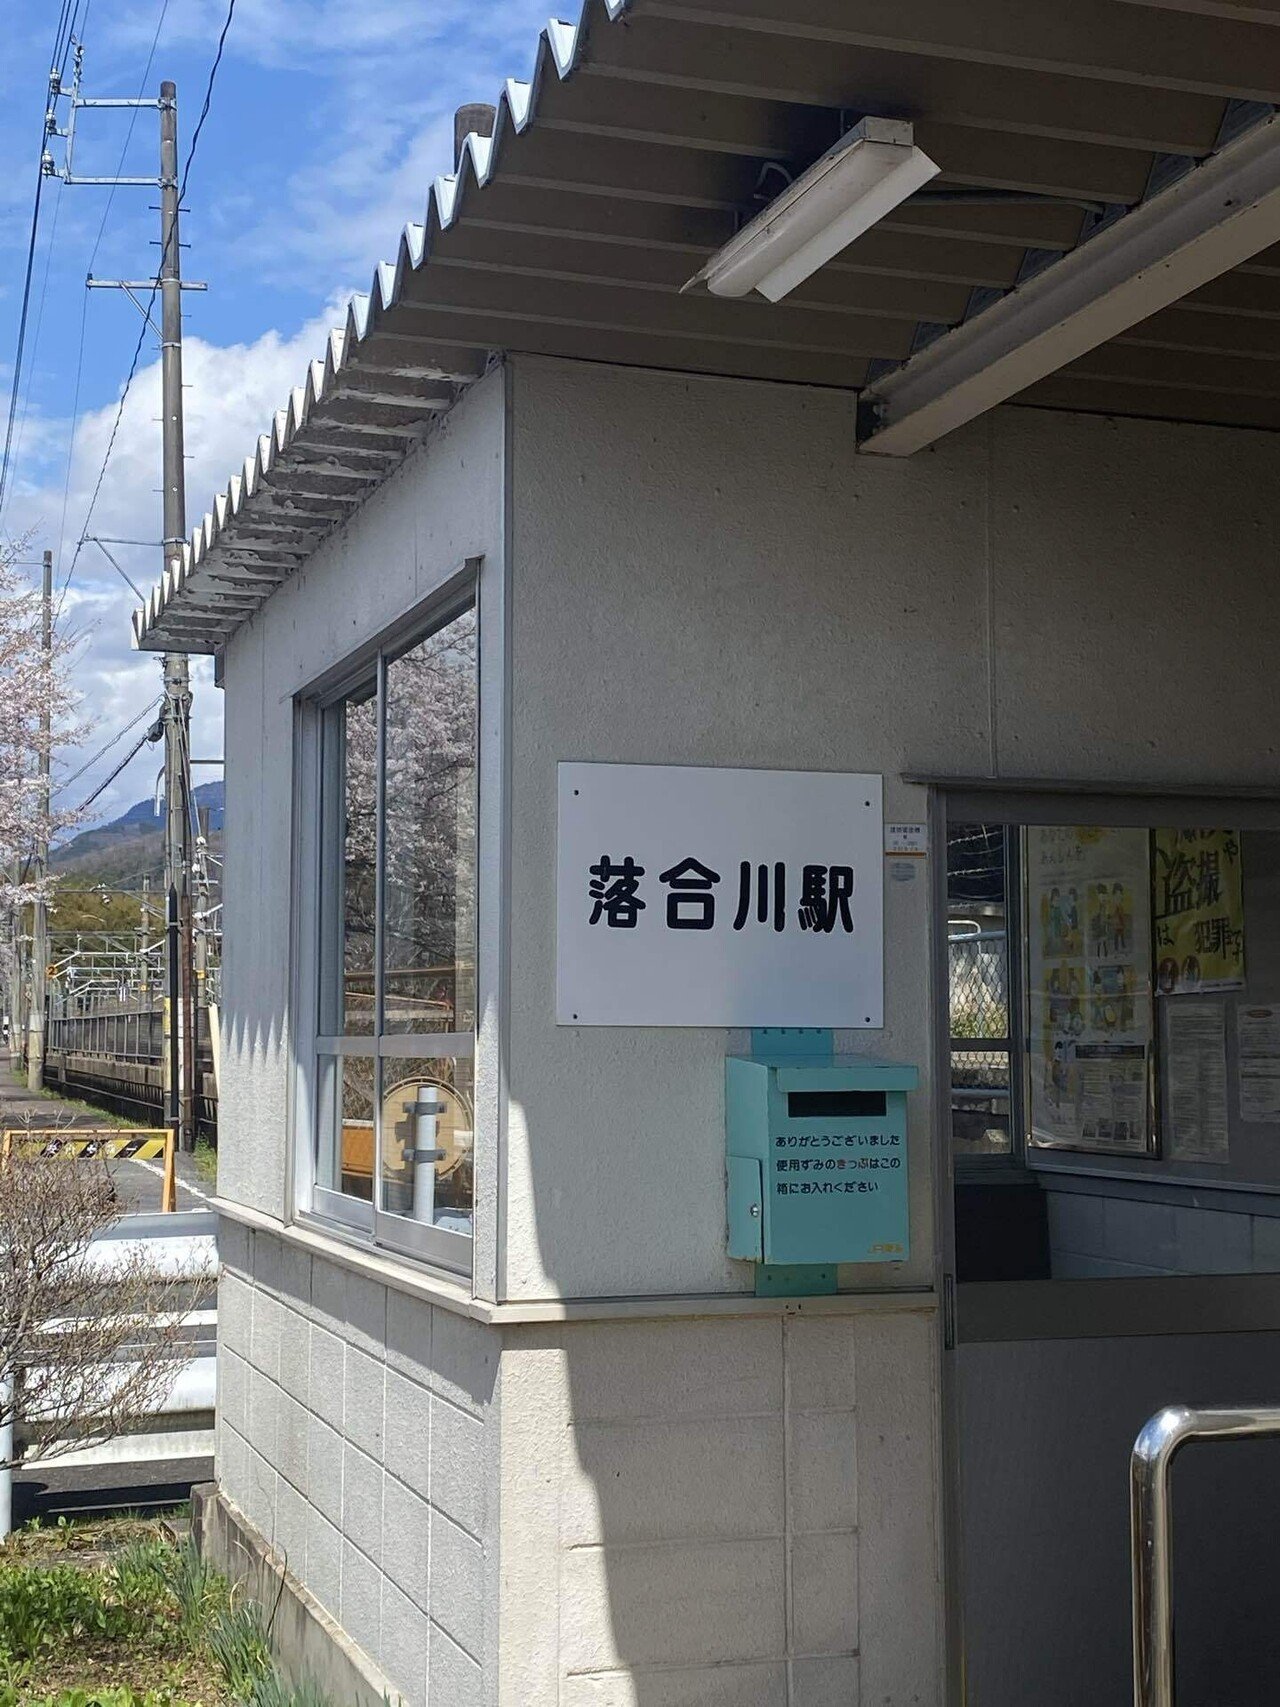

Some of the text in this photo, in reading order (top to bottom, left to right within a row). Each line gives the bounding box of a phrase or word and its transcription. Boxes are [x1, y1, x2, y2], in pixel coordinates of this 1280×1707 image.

[588, 854, 855, 934] 落合川駅
[776, 1135, 900, 1147] ありがとうございました
[776, 1158, 901, 1171] 使用ずみのきっぷはこの
[777, 1182, 878, 1194] 箱にお入れください
